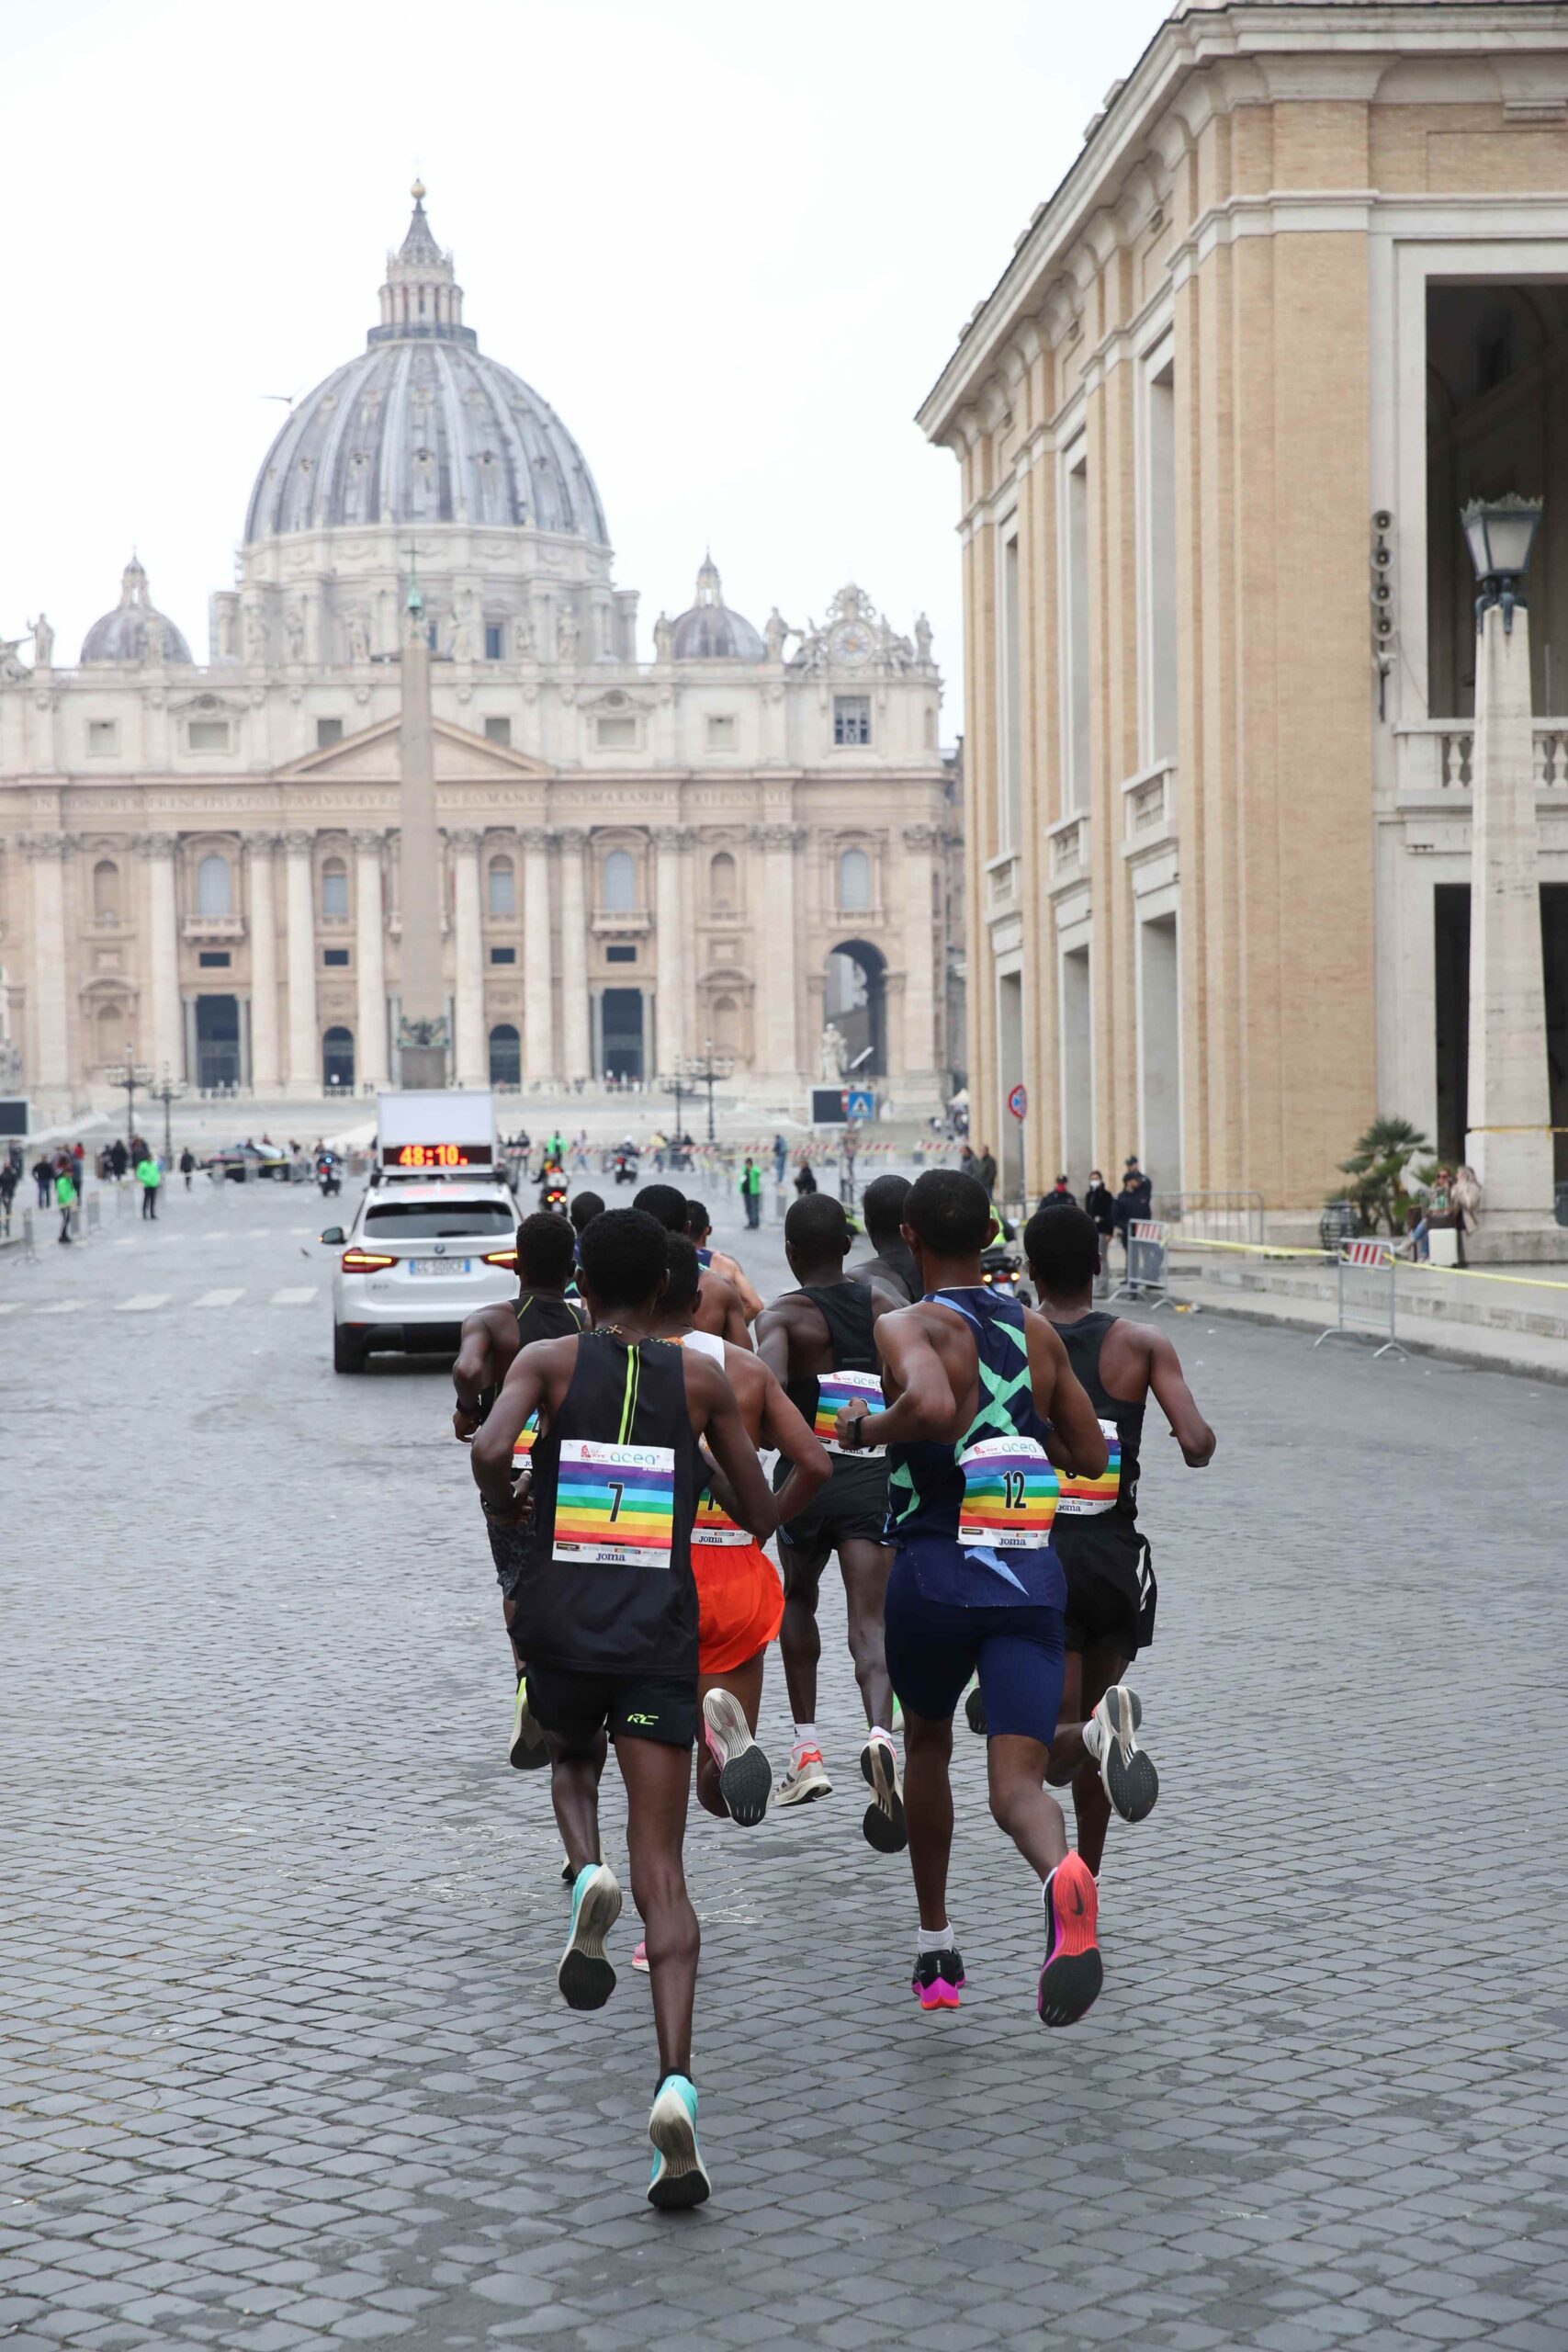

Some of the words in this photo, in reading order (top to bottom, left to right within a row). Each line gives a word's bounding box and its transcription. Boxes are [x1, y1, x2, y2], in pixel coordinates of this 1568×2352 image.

[610, 1452, 655, 1464] acea
[1002, 1442, 1036, 1453] acea
[608, 1482, 624, 1523] 7
[1003, 1471, 1027, 1510] 12
